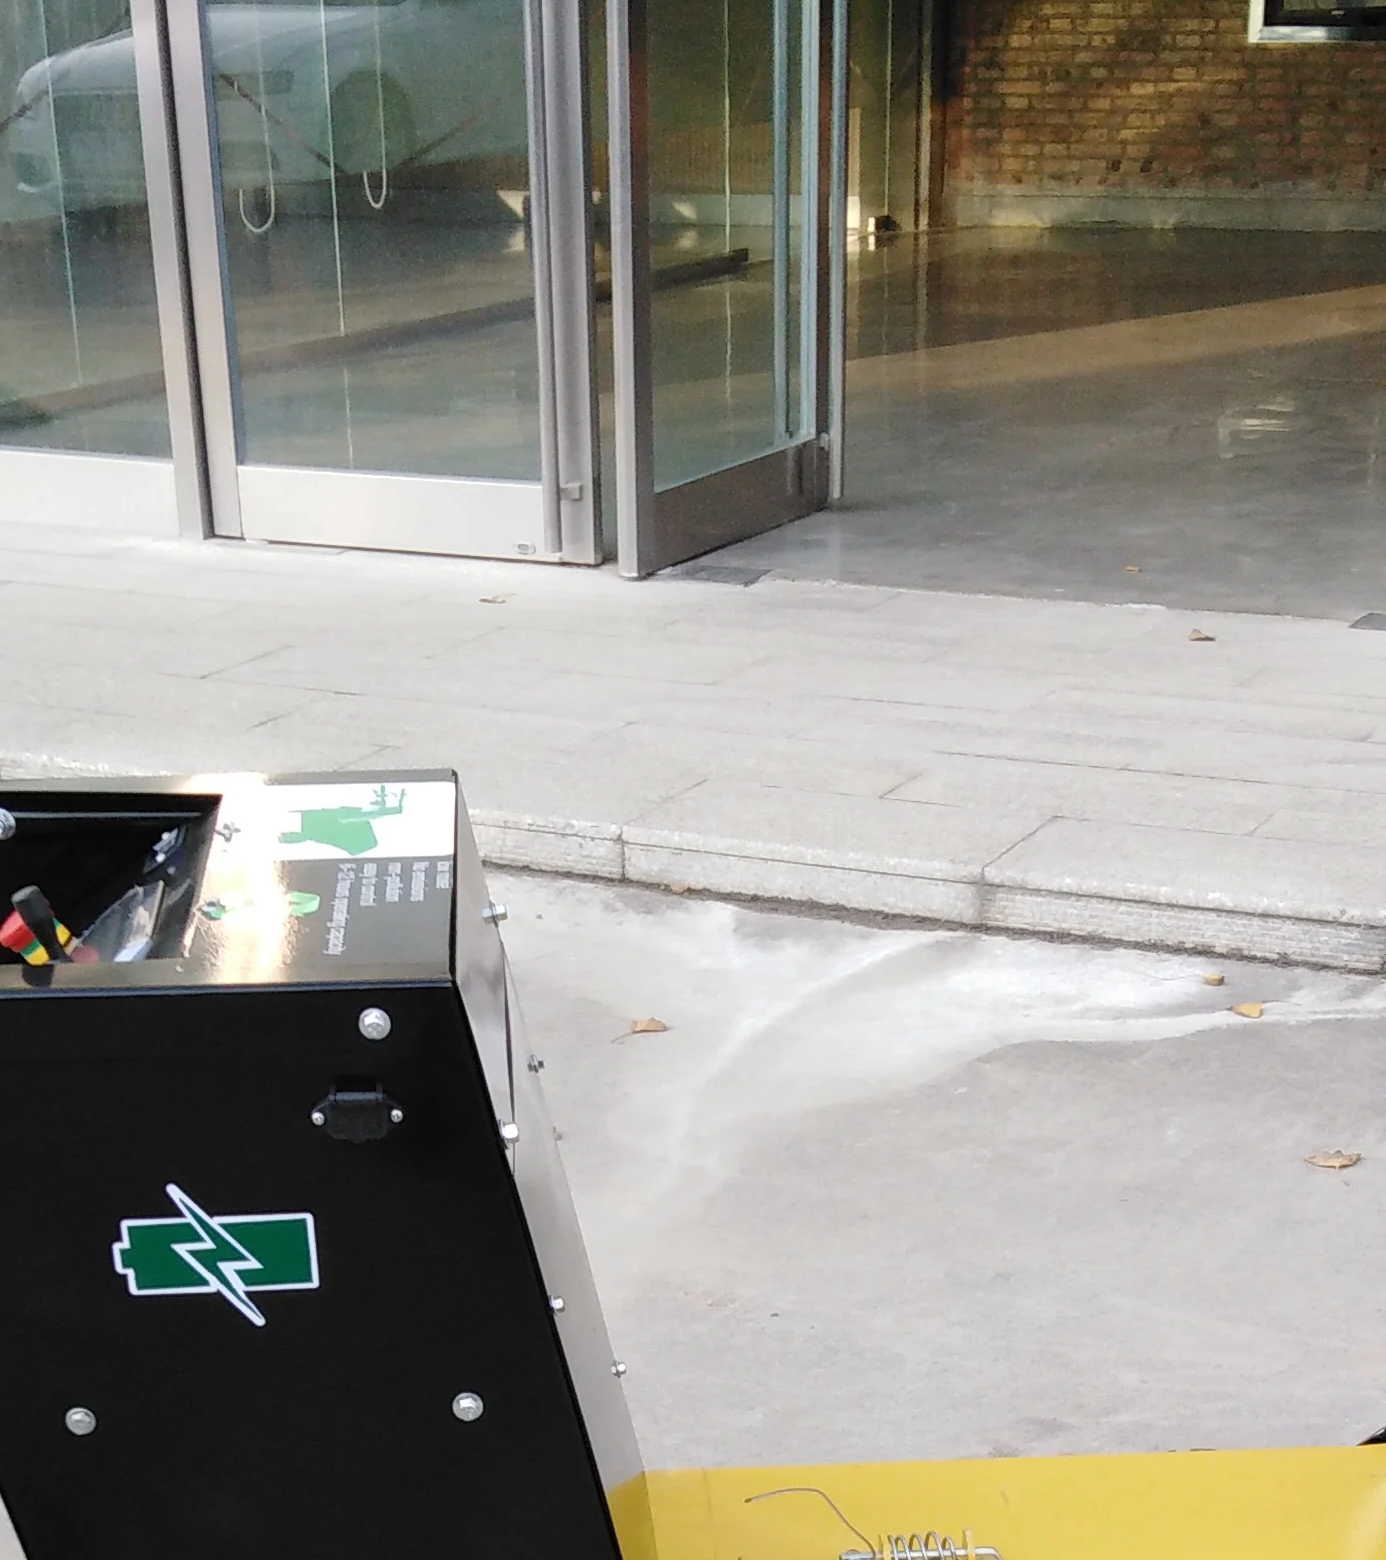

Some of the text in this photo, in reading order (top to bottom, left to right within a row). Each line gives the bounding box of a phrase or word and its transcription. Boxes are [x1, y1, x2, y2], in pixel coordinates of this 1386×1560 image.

[335, 879, 354, 898] hours
[359, 885, 377, 906] control
[410, 871, 428, 902] emissions
[326, 897, 350, 927] operating
[323, 927, 347, 956] capacity
